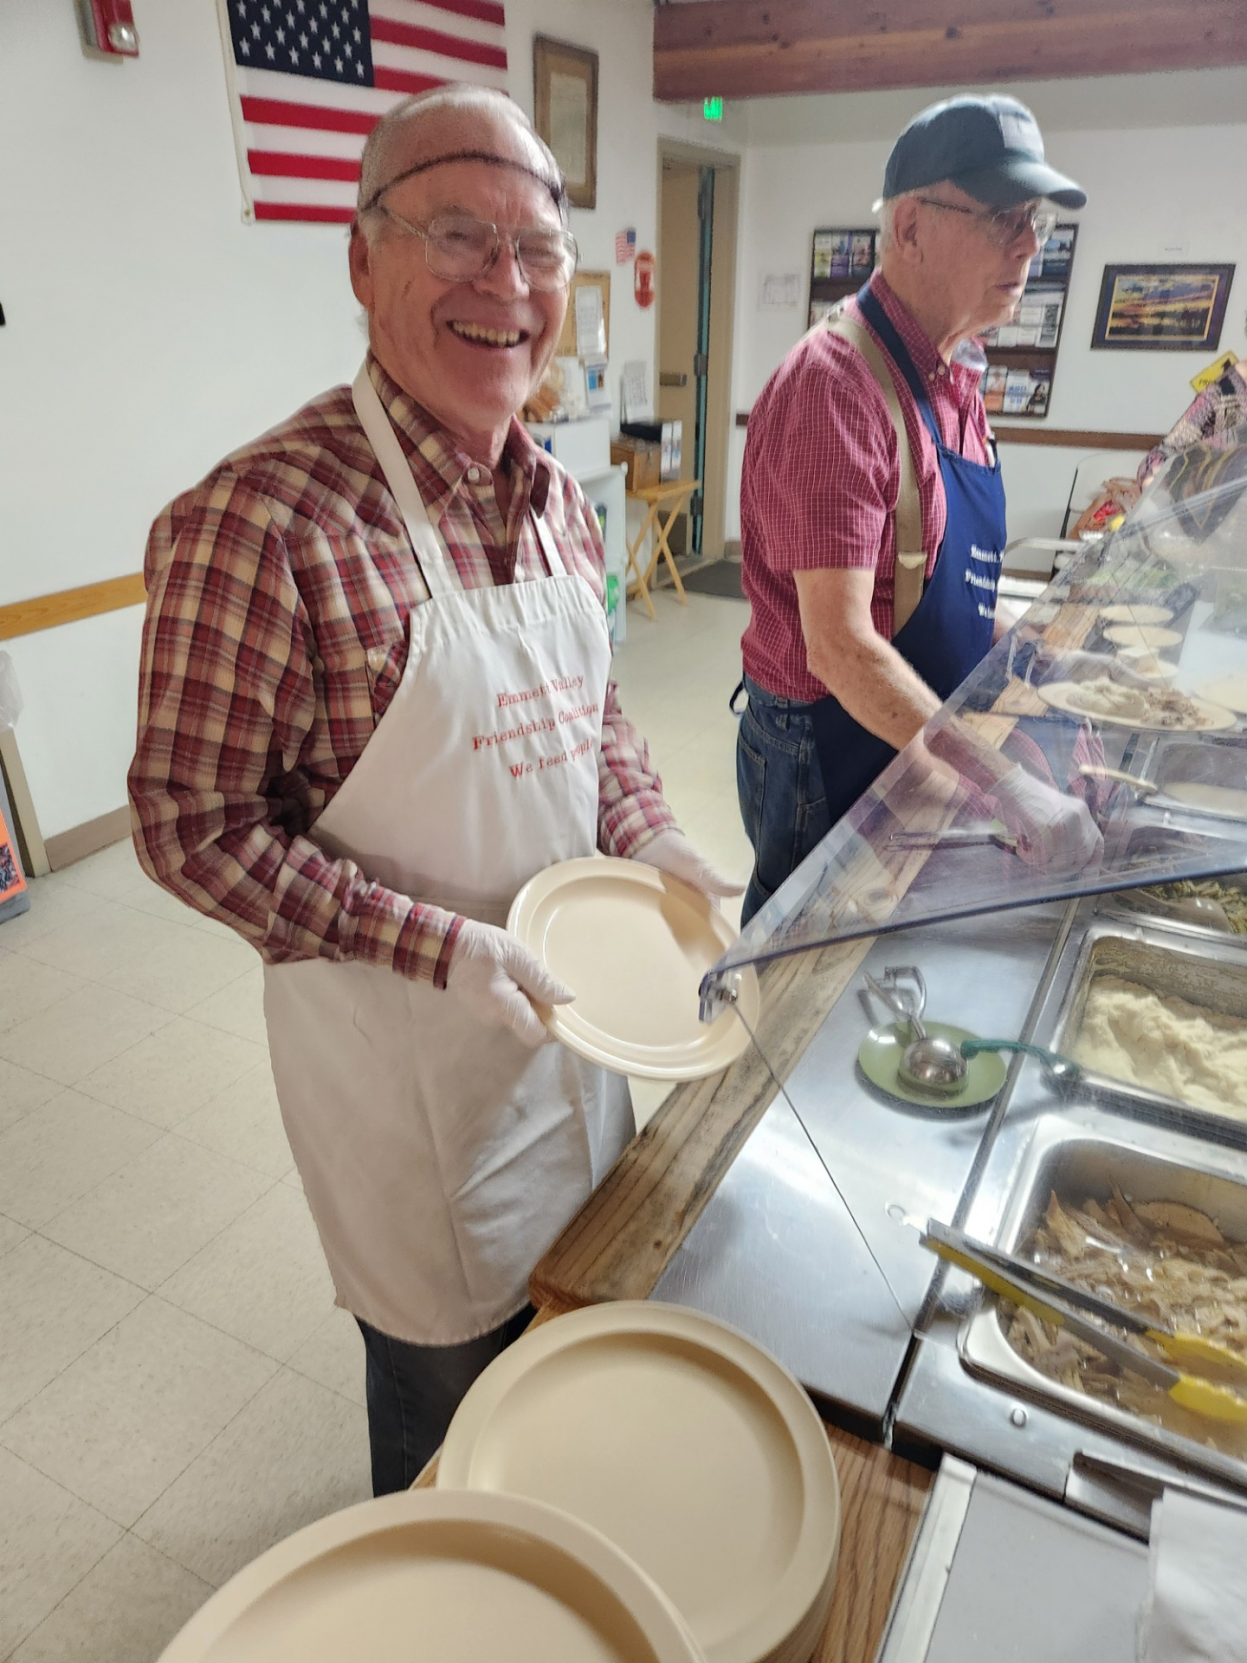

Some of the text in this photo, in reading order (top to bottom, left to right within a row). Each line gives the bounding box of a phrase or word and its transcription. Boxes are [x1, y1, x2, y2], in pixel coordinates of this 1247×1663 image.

[497, 675, 583, 707] Emmett Valley
[472, 703, 598, 751] Friendship Coalition
[509, 761, 533, 778] We
[539, 751, 567, 770] feed
